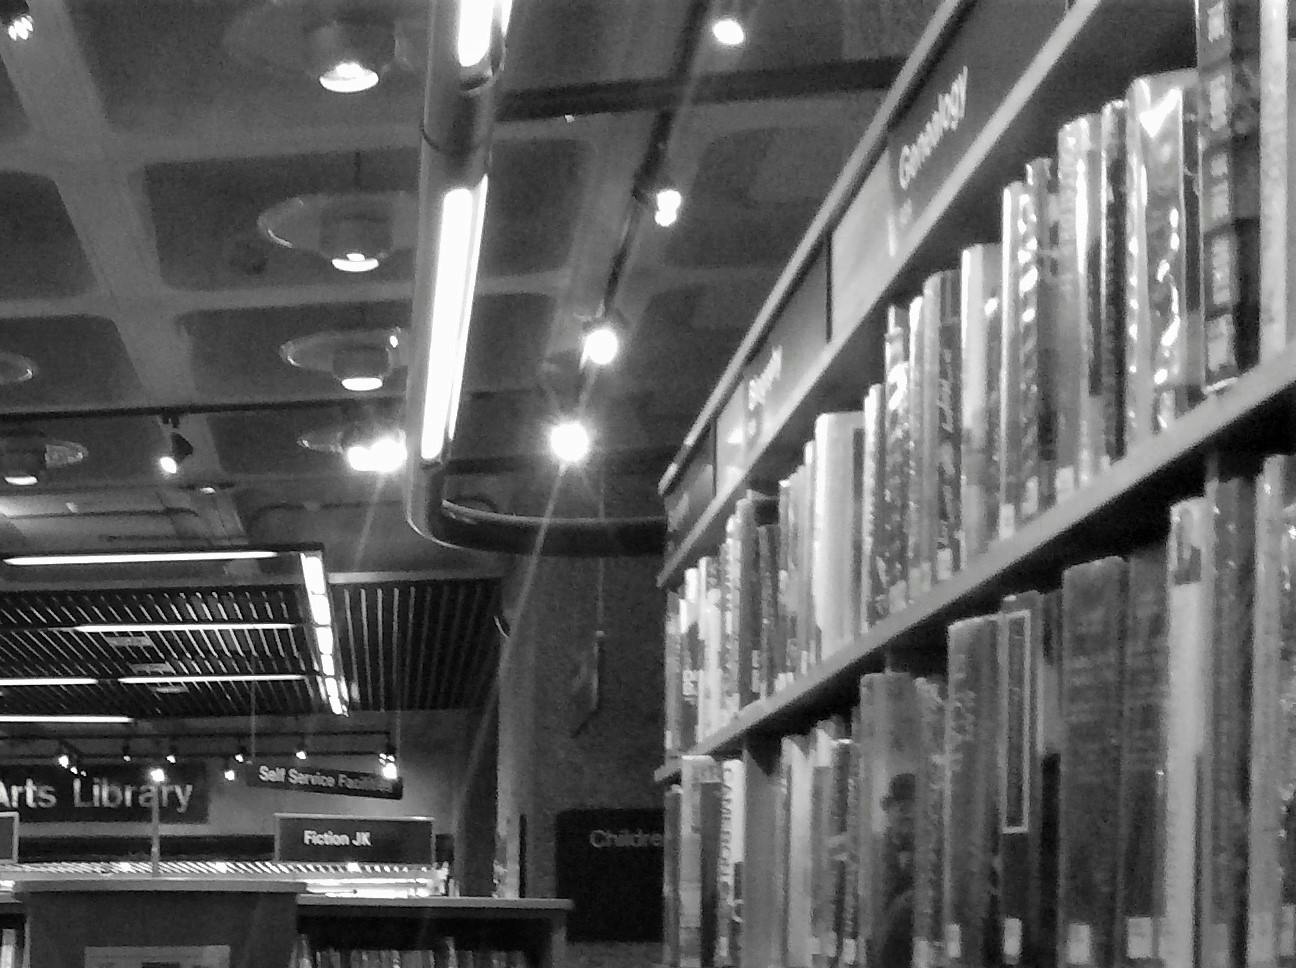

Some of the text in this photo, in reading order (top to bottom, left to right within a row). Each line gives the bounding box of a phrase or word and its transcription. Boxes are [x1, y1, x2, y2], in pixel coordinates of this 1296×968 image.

[259, 765, 287, 783] Self
[288, 768, 336, 787] Service
[72, 777, 194, 814] Library
[303, 830, 372, 846] Fiction JK
[589, 828, 664, 848] Childre
